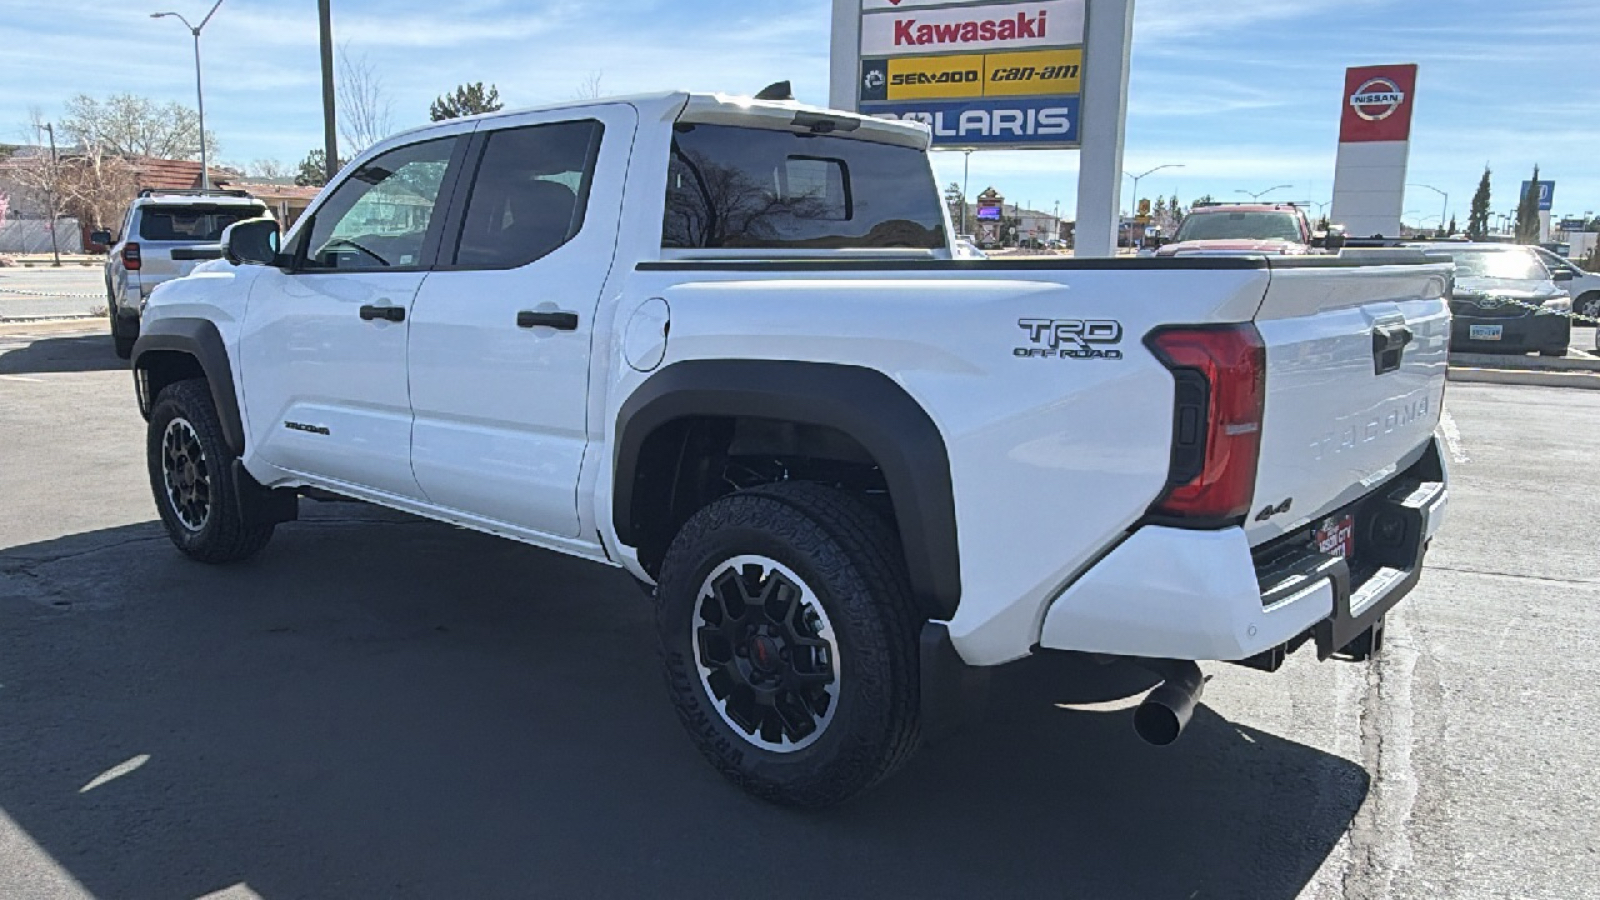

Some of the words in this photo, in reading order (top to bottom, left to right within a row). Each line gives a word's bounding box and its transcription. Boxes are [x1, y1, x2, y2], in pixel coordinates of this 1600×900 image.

[894, 10, 1047, 46] Kawasaki
[990, 64, 1078, 82] can-am
[1354, 94, 1399, 104] NISSAN
[1018, 318, 1123, 348] TRD
[1013, 347, 1057, 358] OFF
[1060, 347, 1123, 360] ROAD
[1309, 395, 1429, 460] TACOMA
